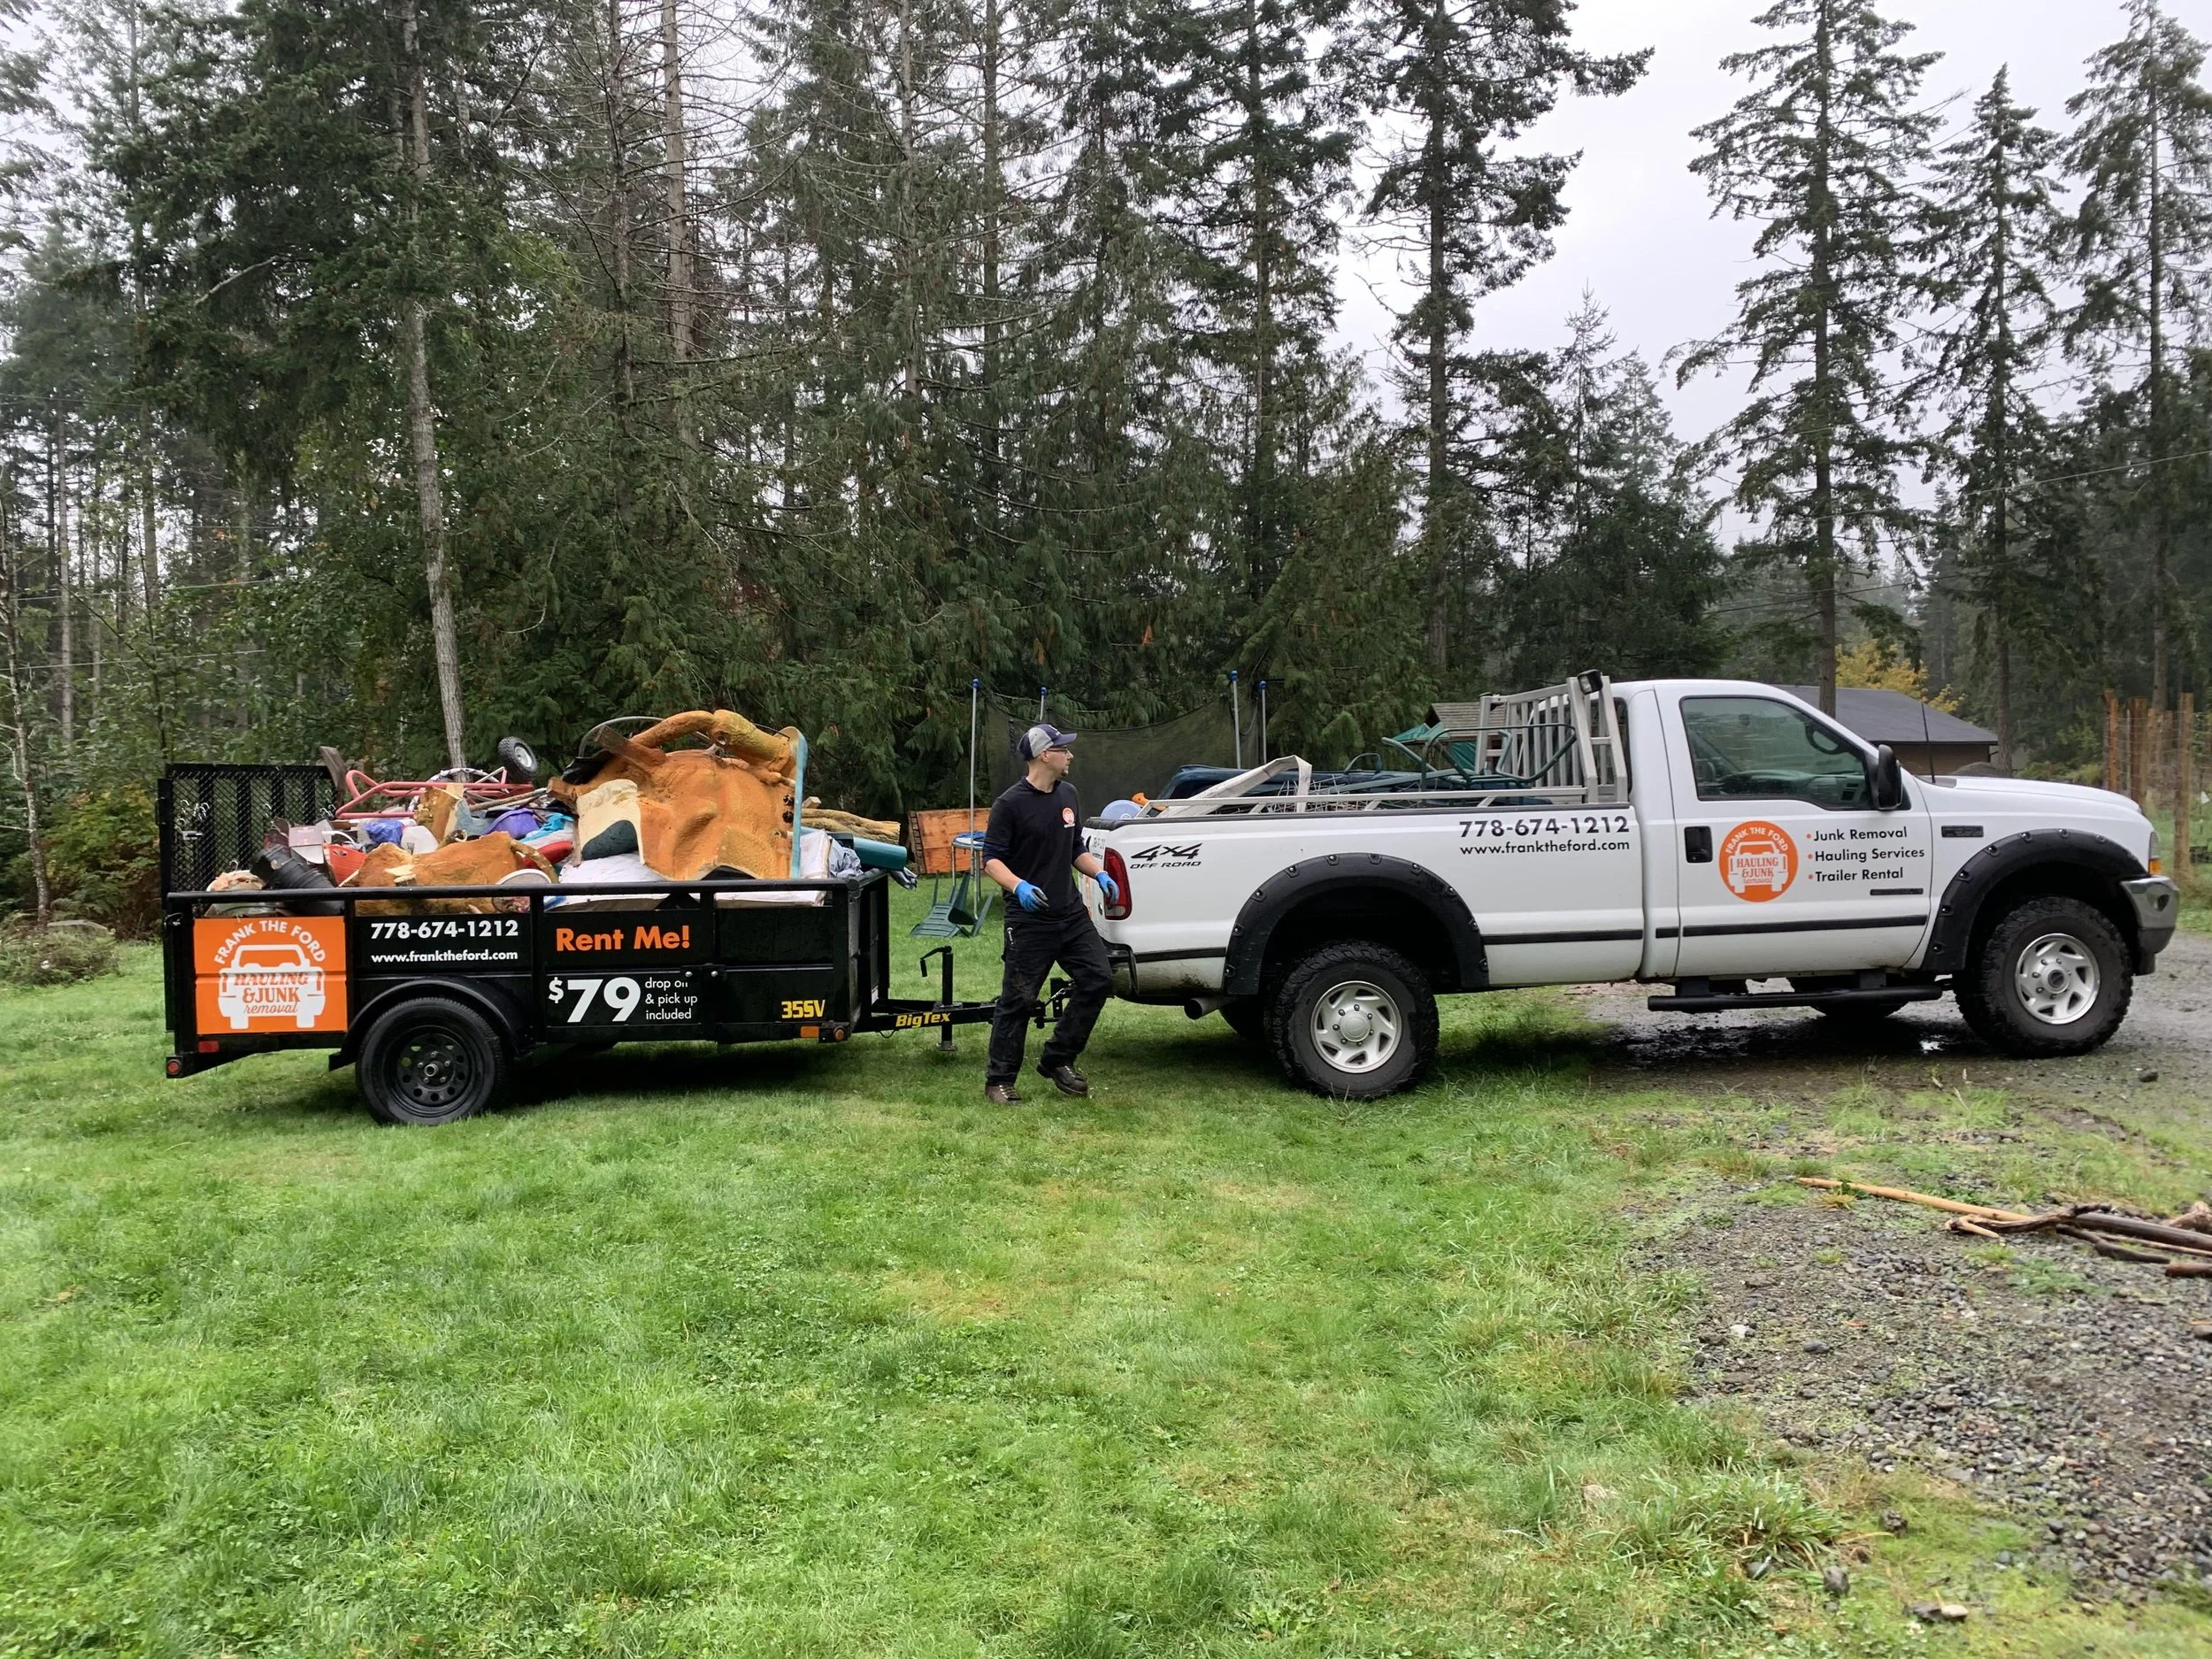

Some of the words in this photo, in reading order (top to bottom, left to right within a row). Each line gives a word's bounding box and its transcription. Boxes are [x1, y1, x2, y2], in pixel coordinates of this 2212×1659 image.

[1459, 816, 1629, 838] 778-674-1212
[1814, 828, 1845, 841] Junk
[1849, 826, 1907, 840] Removal
[1460, 839, 1630, 855] www.franktheford.com
[1725, 829, 1748, 854] FRANK
[1749, 826, 1766, 835] THE
[1768, 829, 1788, 851] FORD
[1131, 842, 1202, 861] 4x4
[1815, 849, 1867, 863] Hauling
[1871, 846, 1924, 860] Services
[1737, 857, 1778, 867] HAULING
[1815, 869, 1857, 882] Trailer
[1862, 867, 1903, 880] Rental
[371, 920, 518, 940] 778-674-1212
[213, 923, 257, 964] FRANK
[259, 920, 288, 933] THE
[290, 925, 326, 962] FORD
[557, 928, 624, 952] Rent
[634, 925, 690, 949] Me!
[371, 949, 518, 963] www.franktheford.com
[234, 973, 309, 986] HAULING
[645, 977, 671, 991] drop
[548, 977, 641, 1023] $79
[645, 994, 655, 1004] &
[658, 992, 680, 1007] pick
[684, 996, 698, 1006] up
[243, 1003, 298, 1014] removal
[646, 1008, 692, 1020] included
[895, 1011, 951, 1028] BigTex
